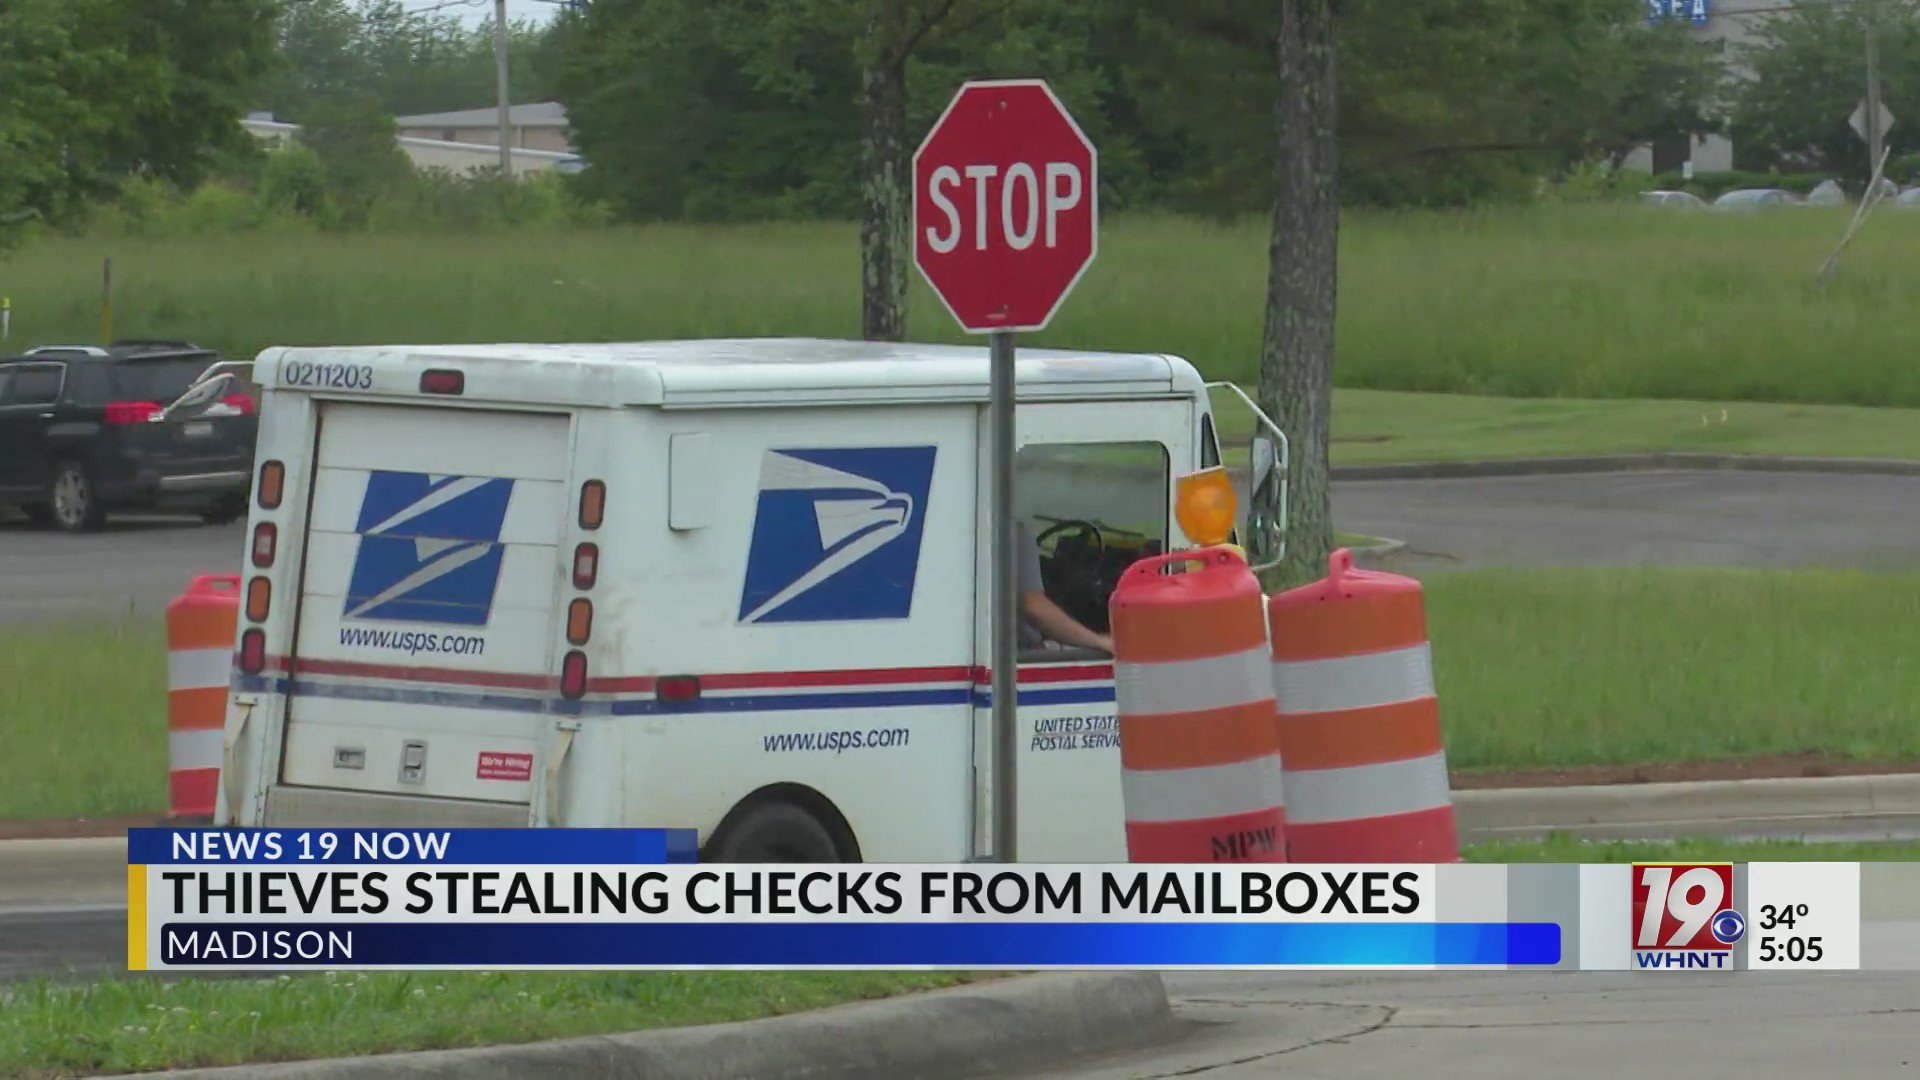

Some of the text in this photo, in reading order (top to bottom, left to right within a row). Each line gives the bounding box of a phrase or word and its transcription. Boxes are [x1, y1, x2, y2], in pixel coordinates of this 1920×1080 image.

[926, 162, 1083, 254] STOP
[285, 361, 373, 389] 0211203
[340, 628, 485, 656] www.usps.com
[1034, 717, 1083, 733] UNITED
[763, 728, 909, 754] www.usps.com
[1031, 736, 1078, 752] POSTAL
[1211, 826, 1277, 861] MPW
